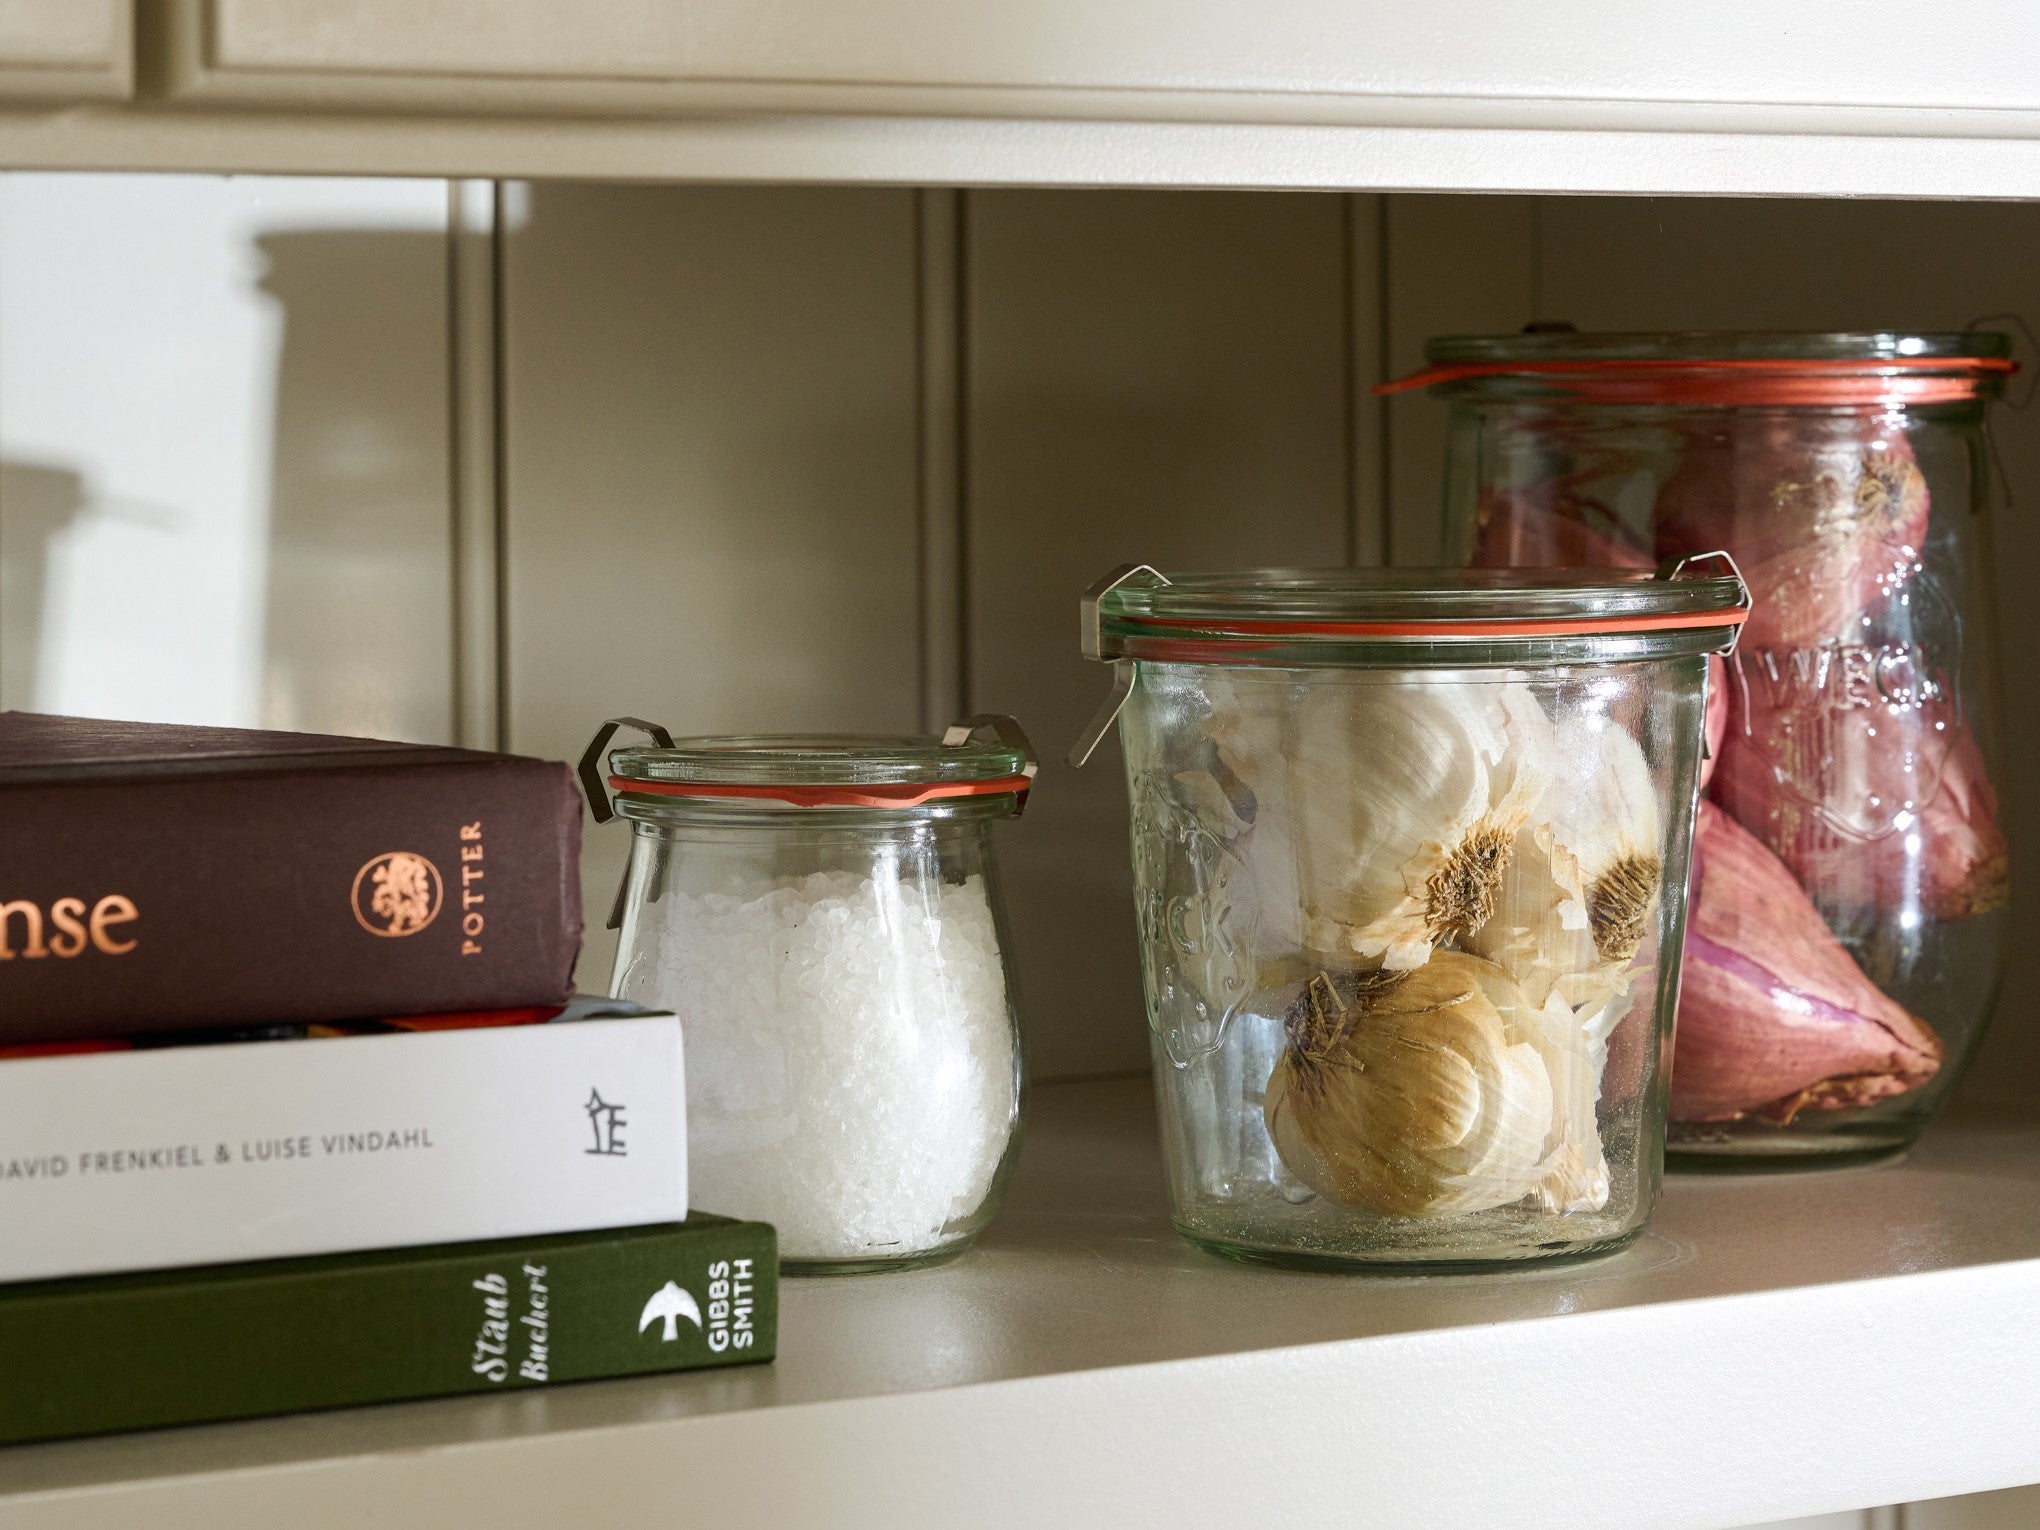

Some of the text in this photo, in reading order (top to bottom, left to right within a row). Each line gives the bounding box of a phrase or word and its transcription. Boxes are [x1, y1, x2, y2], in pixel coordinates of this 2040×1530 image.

[460, 821, 484, 955] POTTER
[79, 1145, 204, 1174] FRENKIEL
[214, 1142, 231, 1164] &
[241, 1136, 312, 1162] LUISE
[321, 1128, 434, 1155] VINDAHL
[472, 1273, 509, 1382] Staub
[519, 1260, 549, 1381] Buchert
[708, 1260, 730, 1353] GIBBS
[733, 1259, 753, 1349] SMITH
